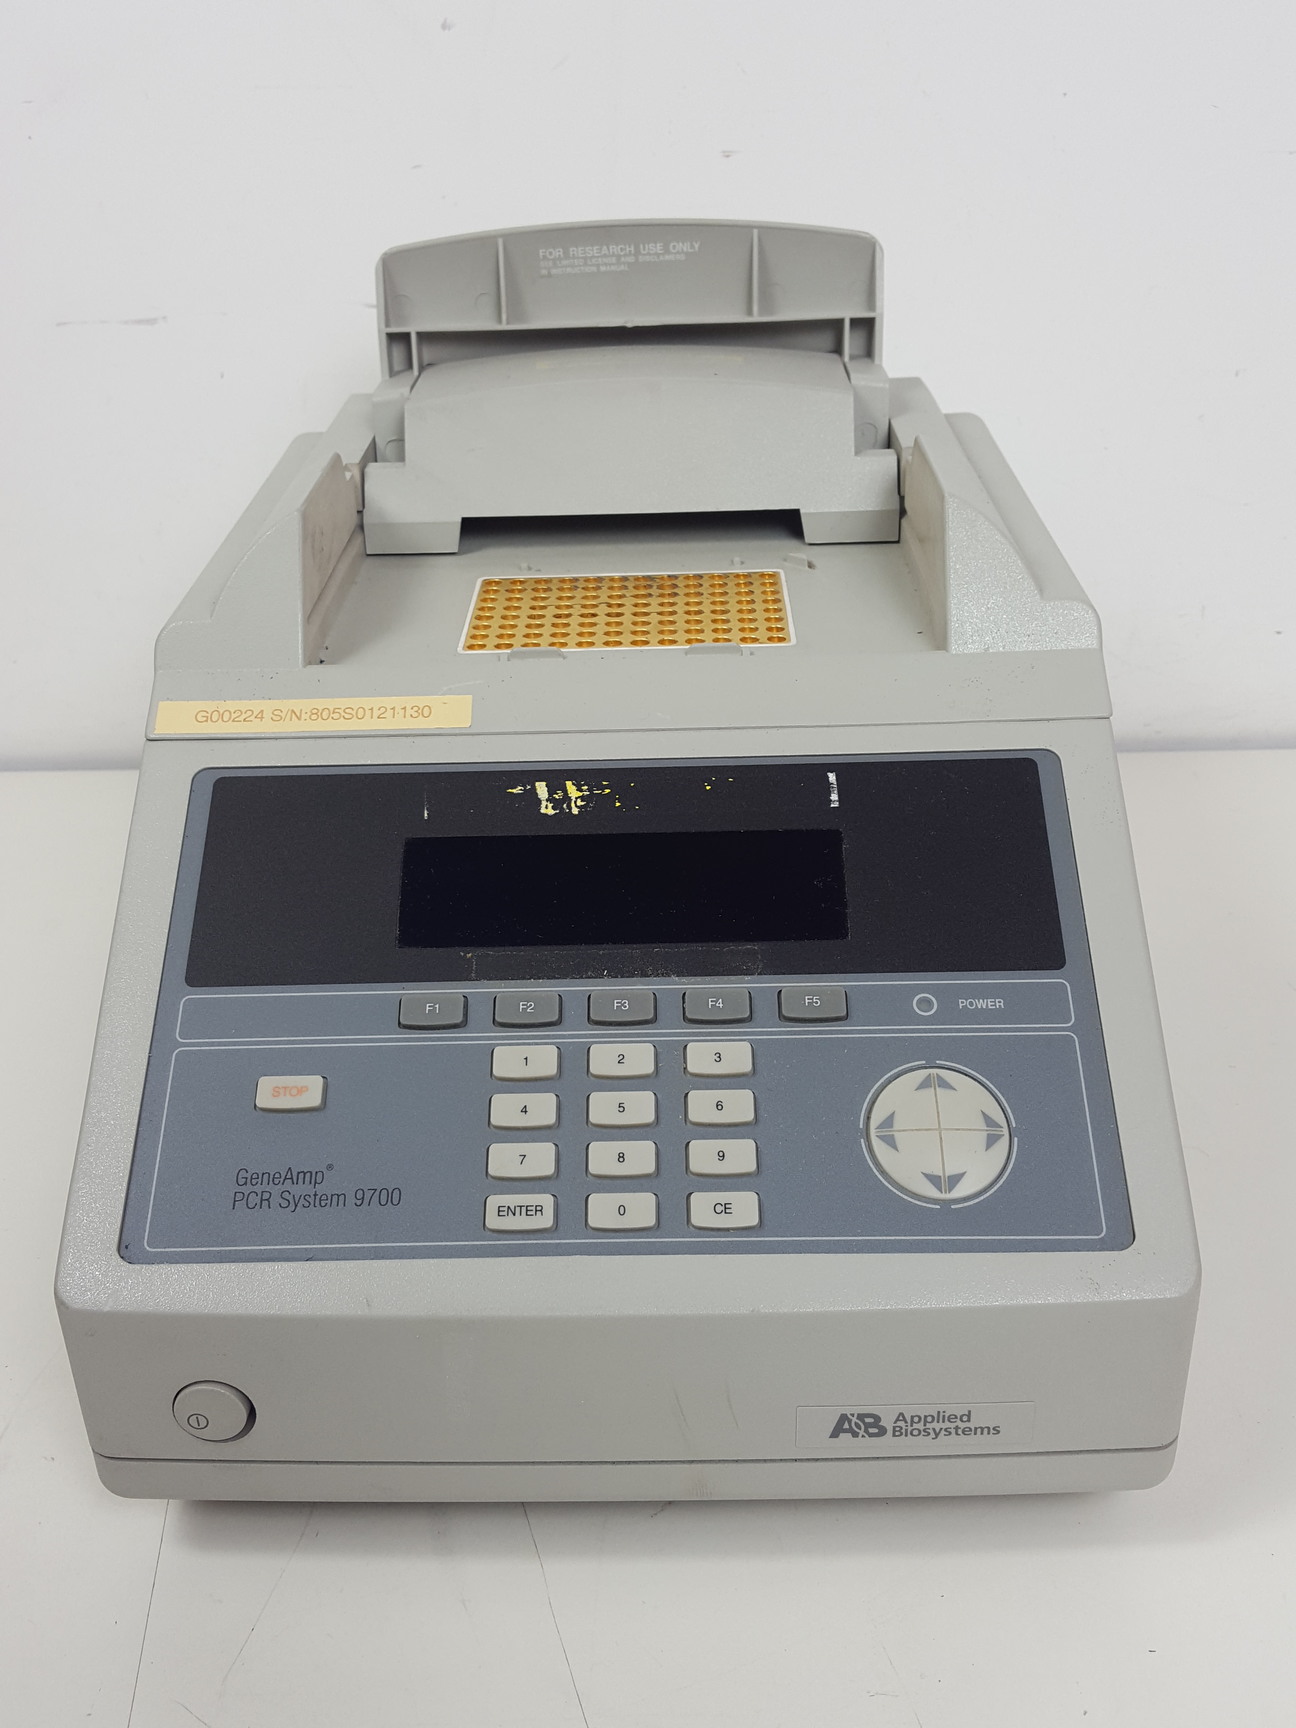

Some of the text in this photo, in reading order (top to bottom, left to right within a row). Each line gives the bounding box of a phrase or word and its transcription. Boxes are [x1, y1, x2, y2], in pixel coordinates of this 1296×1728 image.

[539, 241, 701, 259] FOR RESEARCH USE ONLY
[557, 258, 584, 266] LIMITED
[587, 257, 617, 265] LICENSE
[620, 255, 635, 263] AND
[638, 253, 686, 263] DISCLAIMERS
[550, 266, 597, 275] INSTRUCTION
[600, 264, 629, 272] MANUAL
[194, 704, 432, 724] G00224 S/N:805S0121130
[519, 1001, 535, 1012] F2
[613, 999, 630, 1011] F3
[707, 998, 724, 1009] F4
[804, 995, 821, 1007] F5
[958, 998, 1005, 1009] POWER
[425, 1003, 440, 1014] F1
[617, 1053, 625, 1065] 2
[714, 1051, 722, 1063] 3
[271, 1085, 309, 1098] STOP
[520, 1104, 529, 1115] 4
[617, 1102, 626, 1113] 5
[715, 1100, 724, 1112] 6
[518, 1154, 527, 1165] 7
[617, 1151, 626, 1163] 8
[717, 1150, 726, 1162] 9
[232, 1187, 402, 1213] PCR System 9700
[496, 1204, 544, 1217] ENTER
[617, 1204, 627, 1217] 0
[713, 1202, 733, 1215] CE
[893, 1410, 972, 1428] Applied
[891, 1424, 1001, 1440] Biosystems
